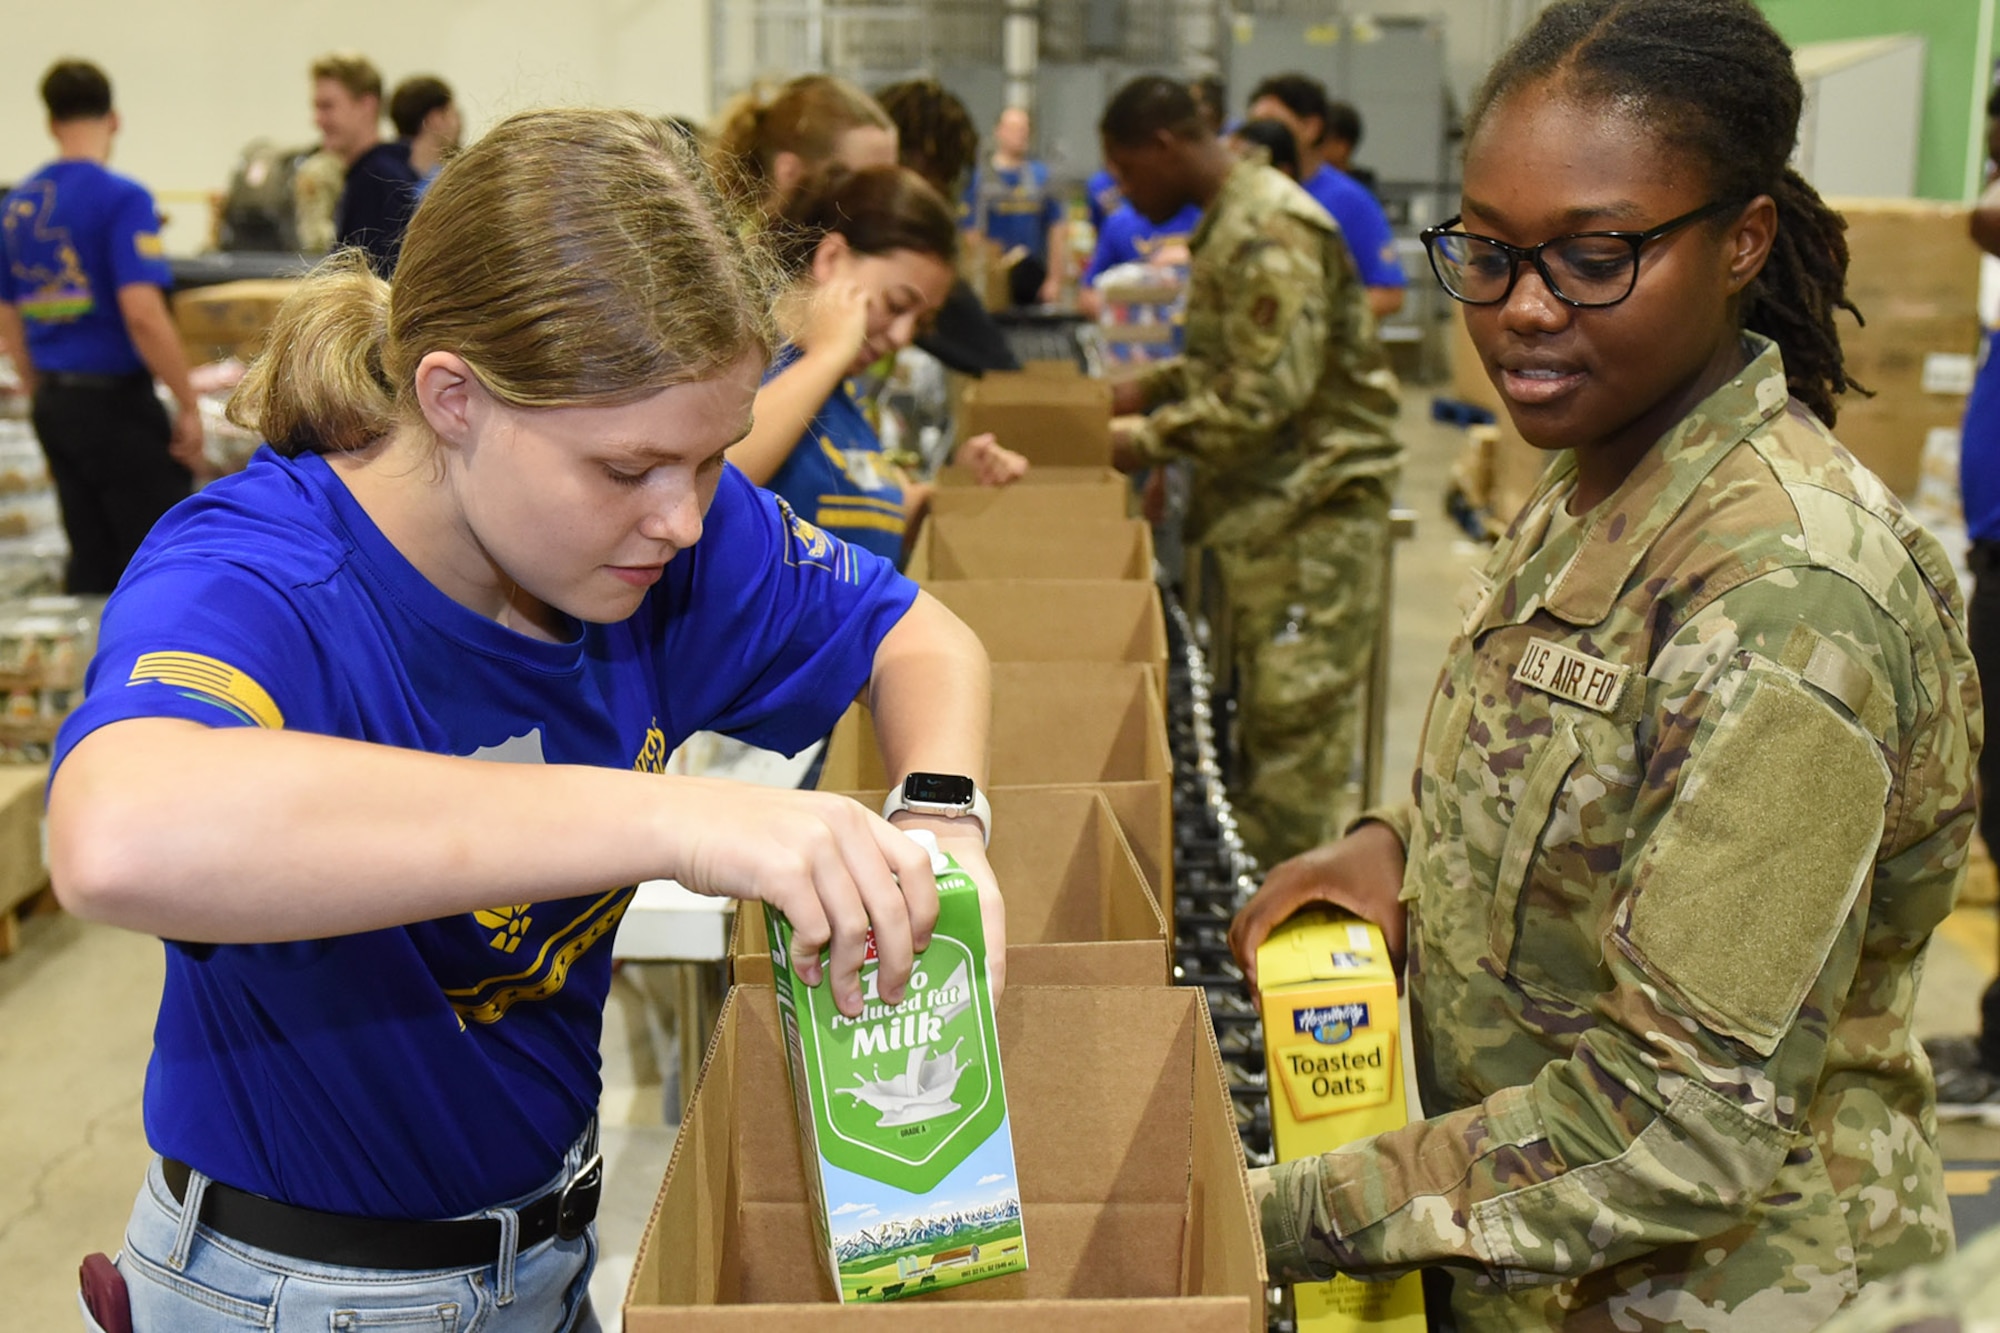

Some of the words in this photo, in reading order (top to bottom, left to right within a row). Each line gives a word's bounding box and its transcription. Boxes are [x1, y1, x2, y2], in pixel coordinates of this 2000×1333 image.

[1519, 644, 1551, 683] U.S.
[1550, 655, 1586, 697] AIR
[1583, 667, 1619, 706] FO
[926, 986, 960, 1008] fat
[851, 1011, 942, 1059] Milk
[1286, 1046, 1381, 1076] Toasted
[1312, 1076, 1366, 1098] Oats
[900, 1126, 920, 1138] GRADE
